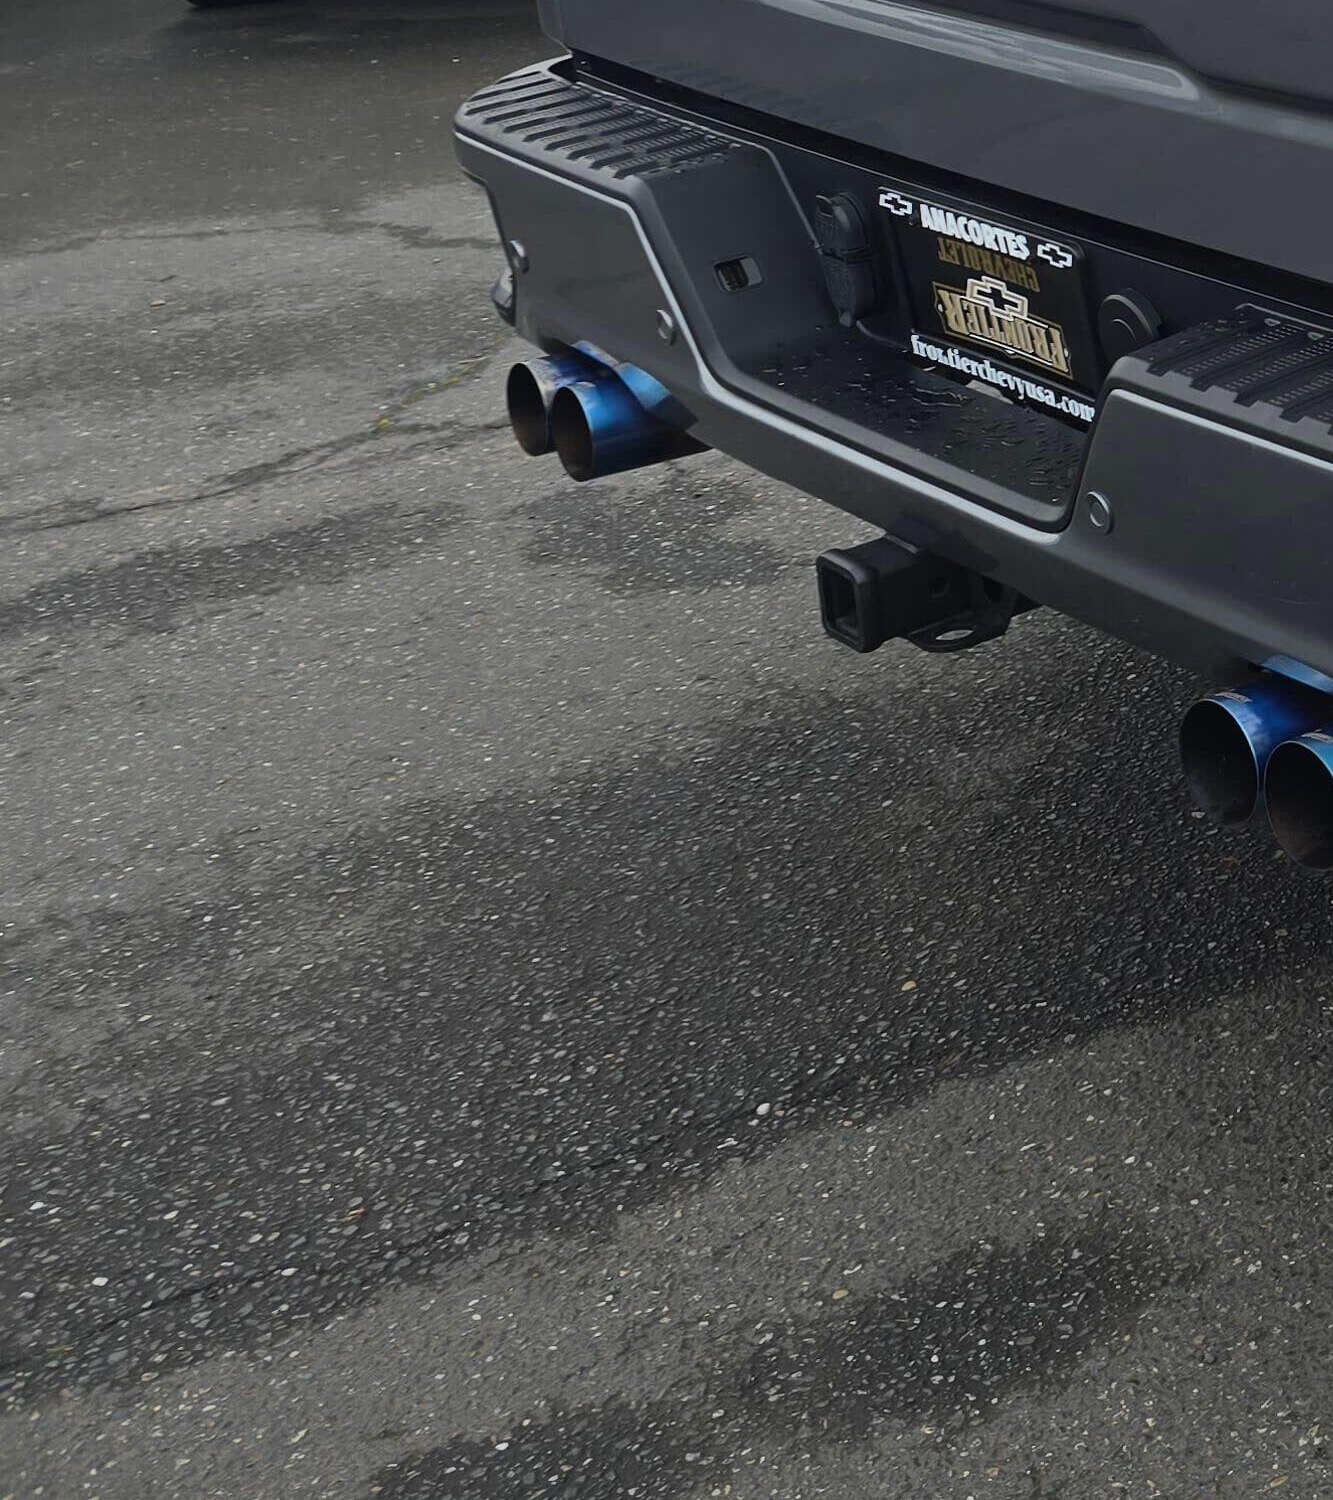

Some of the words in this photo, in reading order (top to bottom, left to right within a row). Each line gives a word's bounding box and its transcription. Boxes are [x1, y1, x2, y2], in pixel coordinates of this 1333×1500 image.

[919, 203, 1030, 261] ANACORTES
[936, 236, 1041, 293] CHEVROLET
[936, 288, 1070, 373] FRONTIER
